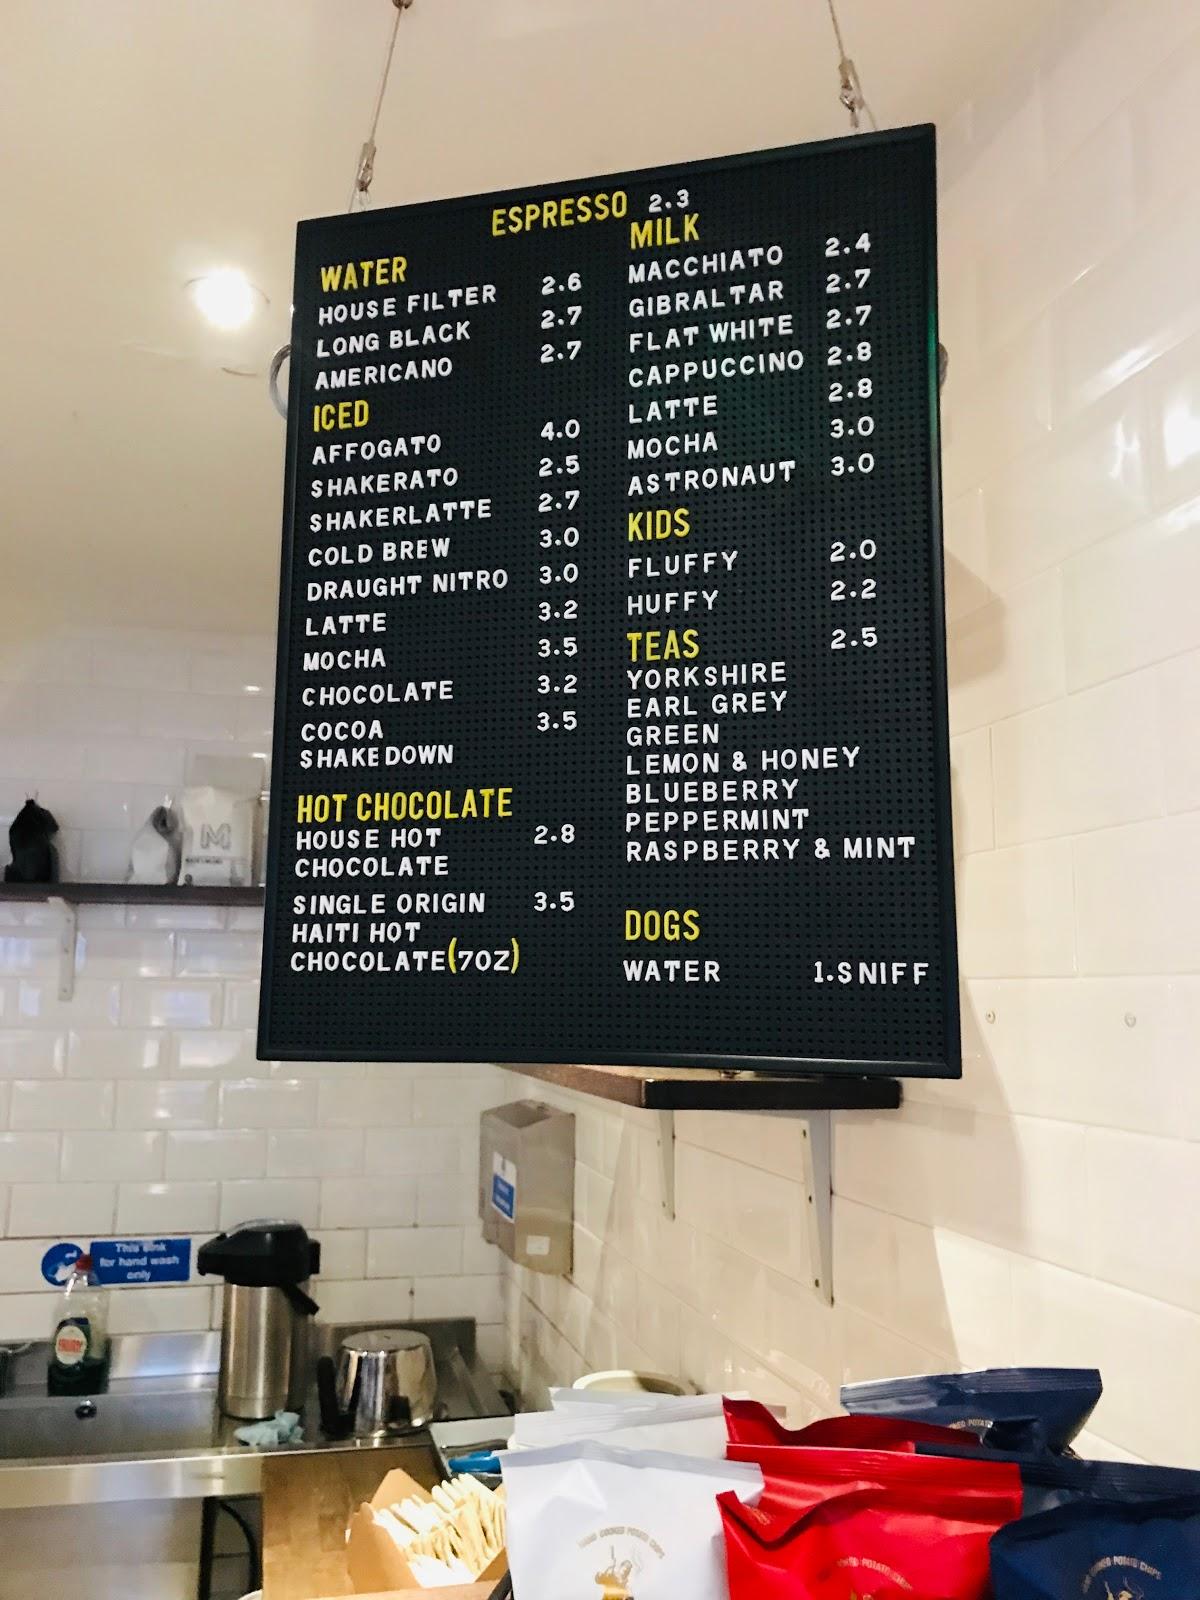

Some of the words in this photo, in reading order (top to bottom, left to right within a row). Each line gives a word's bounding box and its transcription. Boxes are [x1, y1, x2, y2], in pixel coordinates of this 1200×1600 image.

[493, 191, 627, 236] ESPRESSO
[649, 189, 688, 212] 2.3
[631, 213, 699, 249] MILK
[321, 257, 406, 292] WATER
[629, 246, 782, 283] MACCHIATO
[825, 233, 870, 257] 2.4
[319, 298, 396, 326] HOUSE
[408, 285, 496, 313] FILTER
[542, 273, 581, 295] 2.6
[629, 281, 783, 317] GIBRALTAR
[826, 269, 870, 293] 2.7
[317, 333, 379, 358] LONG
[390, 321, 470, 349] BLACK
[541, 306, 582, 329] 2.7
[630, 326, 698, 353] FLAT
[709, 315, 793, 343] WHITE
[827, 305, 871, 329] 2.7
[315, 357, 452, 390] AMERICANO
[541, 341, 581, 363] 2.7
[629, 350, 803, 387] CAPPUCCINO
[828, 342, 871, 365] 2.8
[314, 400, 368, 432] ICED
[629, 395, 717, 423] LATTE
[829, 378, 872, 402] 2.8
[312, 434, 441, 465] AFFOGATO
[541, 419, 580, 440] 4.0
[628, 432, 718, 459] MOCHA
[831, 416, 874, 438] 3.0
[311, 468, 458, 498] SHAKERATO
[539, 455, 579, 477] 2.5
[628, 460, 795, 496] ASTRONAUT
[831, 453, 874, 476] 3.0
[310, 499, 491, 532] SHAKERLATTE
[539, 490, 580, 512] 2.7
[629, 508, 690, 541] KIDS
[308, 544, 373, 566] COLD
[383, 538, 450, 561] BREW
[540, 527, 579, 548] 3.0
[629, 551, 738, 578] FLUFFY
[830, 539, 876, 562] 2.0
[308, 575, 422, 601] DRAUGHT
[433, 569, 507, 593] NITRO
[540, 563, 578, 584] 3.0
[628, 590, 718, 615] HUFFY
[831, 579, 876, 600] 2.2
[306, 613, 386, 636] LATTE
[538, 600, 578, 621] 3.2
[303, 648, 386, 671] MOCHA
[538, 637, 577, 657] 3.5
[627, 629, 699, 662] TEAS
[831, 627, 877, 649] 2.5
[302, 681, 453, 706] CHOCOLATE
[538, 675, 577, 693] 3.2
[627, 662, 786, 689] YORKSHIRE
[628, 696, 697, 718] EARL
[712, 691, 787, 714] GREY
[301, 720, 383, 742] COCOA
[537, 711, 577, 731] 3.5
[627, 724, 718, 746] GREEN
[627, 753, 719, 775] LEMON
[732, 751, 747, 772] &
[762, 746, 860, 771] HONEY
[298, 794, 347, 823] HOT
[357, 788, 512, 821] CHOCOLATE
[627, 779, 798, 804] BLUEBERRY
[297, 829, 379, 850] HOUSE
[391, 828, 441, 848] HOT
[534, 824, 574, 844] 2.8
[626, 809, 809, 833] PEPPERMINT
[295, 856, 448, 878] CHOCOLATE
[627, 839, 800, 862] RASPBERRY
[815, 838, 830, 859] &
[844, 837, 915, 858] MINT
[293, 894, 385, 914] SINGLE
[397, 893, 485, 914] ORIGIN
[534, 892, 574, 911] 3.5
[292, 923, 358, 943] HAITI
[370, 922, 420, 943] HOT
[626, 910, 699, 940] DOGS
[623, 960, 720, 982] WATER
[118, 1255, 148, 1267] hand
